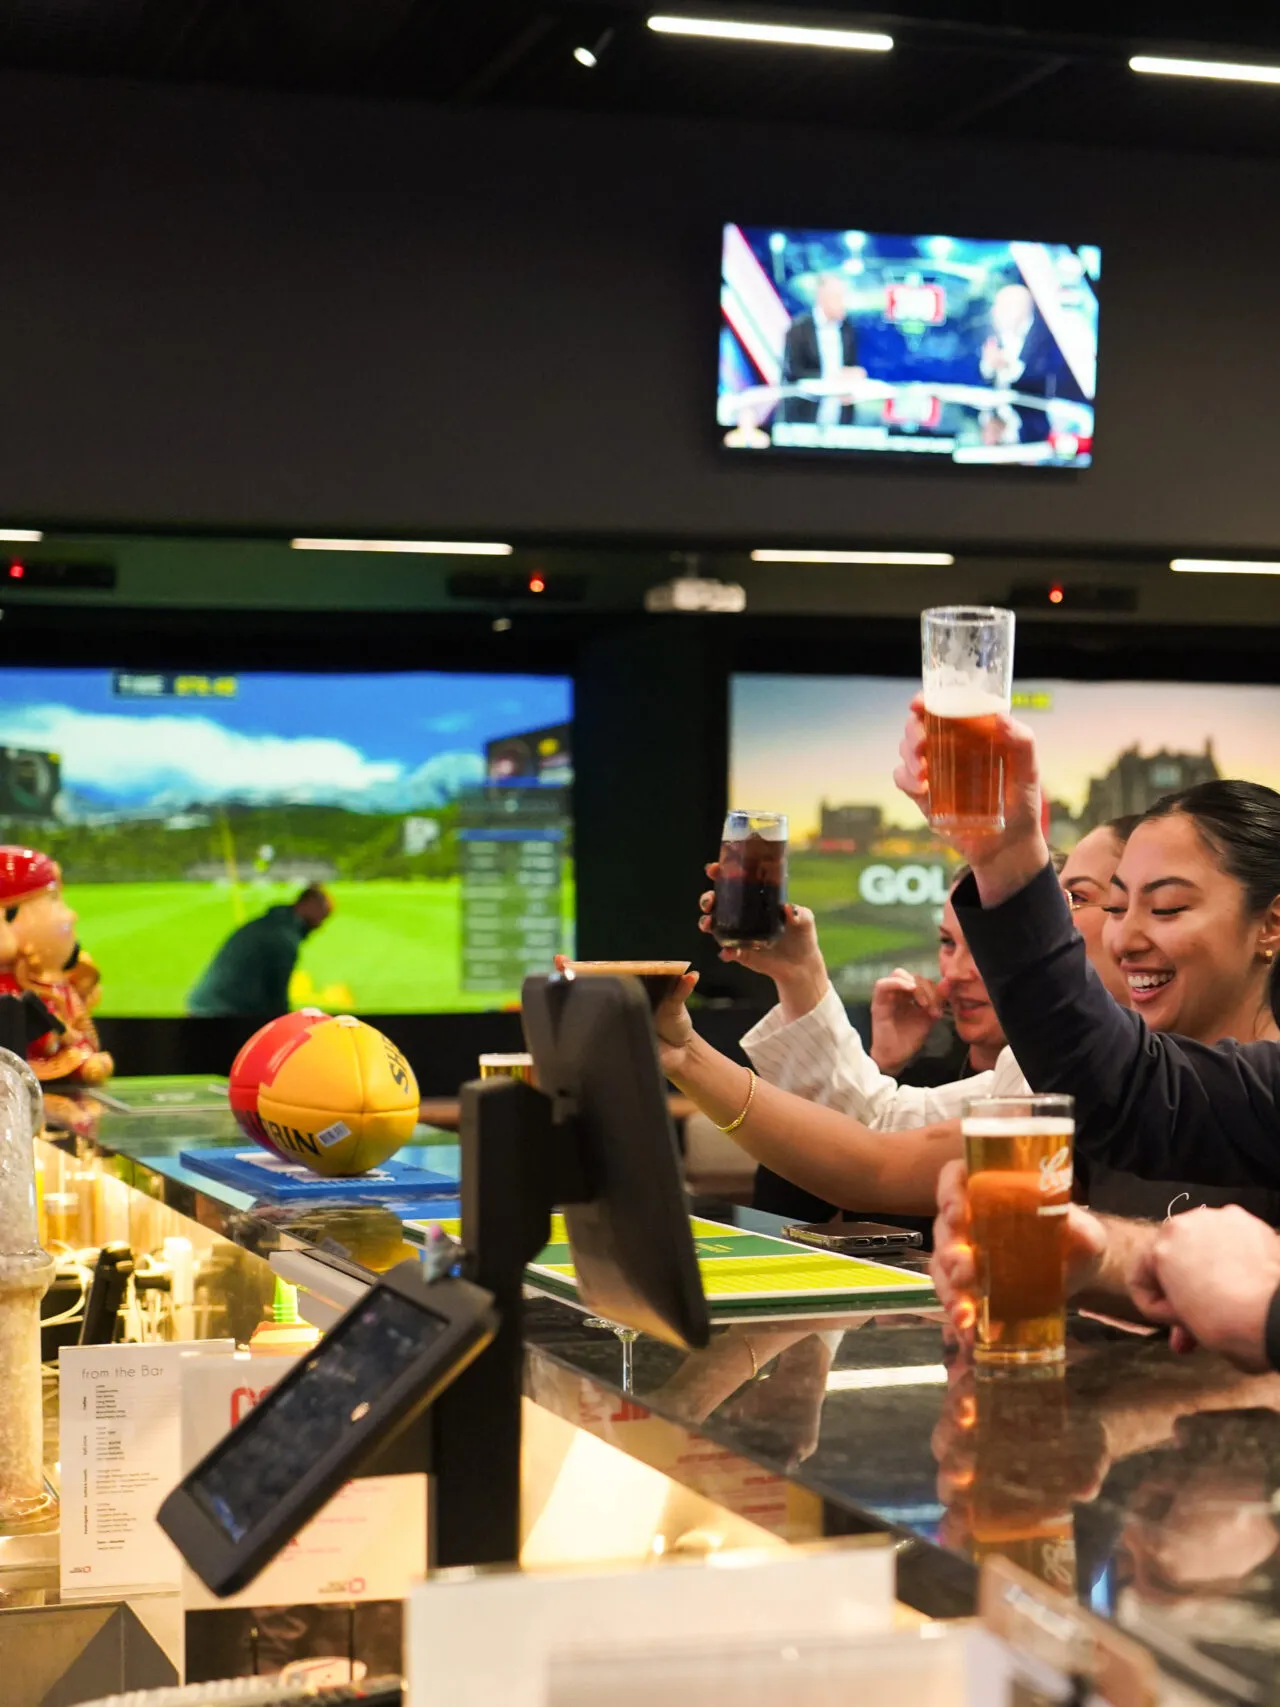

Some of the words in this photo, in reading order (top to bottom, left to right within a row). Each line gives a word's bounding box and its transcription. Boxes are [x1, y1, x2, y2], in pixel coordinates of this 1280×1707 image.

[81, 1368, 110, 1380] from
[115, 1366, 136, 1378] the
[141, 1364, 164, 1377] Bar
